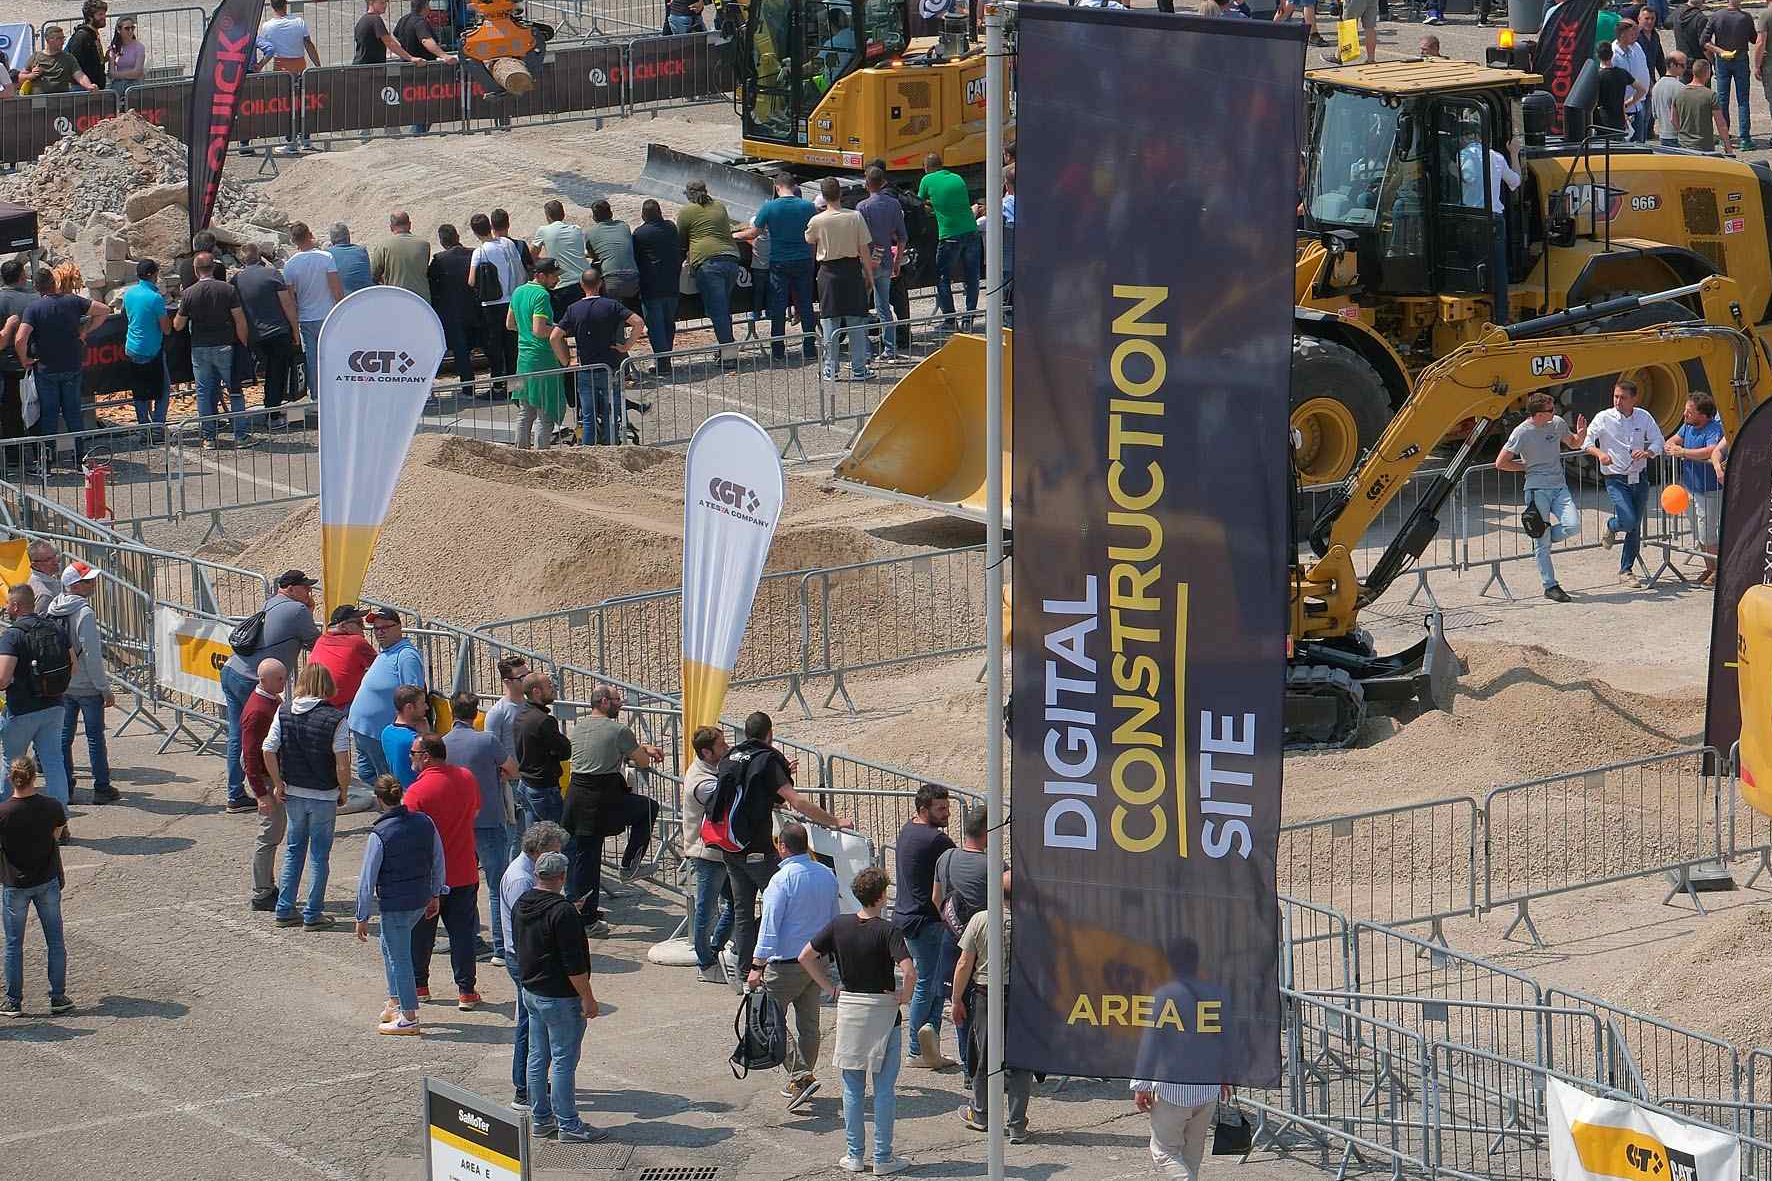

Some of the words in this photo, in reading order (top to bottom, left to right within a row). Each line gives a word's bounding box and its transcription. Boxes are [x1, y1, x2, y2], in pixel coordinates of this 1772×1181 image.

[1565, 184, 1608, 216] CAT
[1631, 197, 1656, 211] 966
[348, 350, 396, 374] CGT
[1531, 355, 1562, 375] CAT
[378, 375, 427, 384] COMPANY
[709, 477, 747, 509] CGT
[731, 509, 769, 529] COMPANY
[1107, 284, 1169, 853] CONSTRUCTION
[1042, 574, 1098, 851] DIGITAL
[1199, 709, 1256, 860] SITE
[1066, 994, 1185, 1032] AREA
[1196, 1001, 1223, 1033] E
[458, 1109, 491, 1133] SaMoTer
[460, 1159, 481, 1176] AREA
